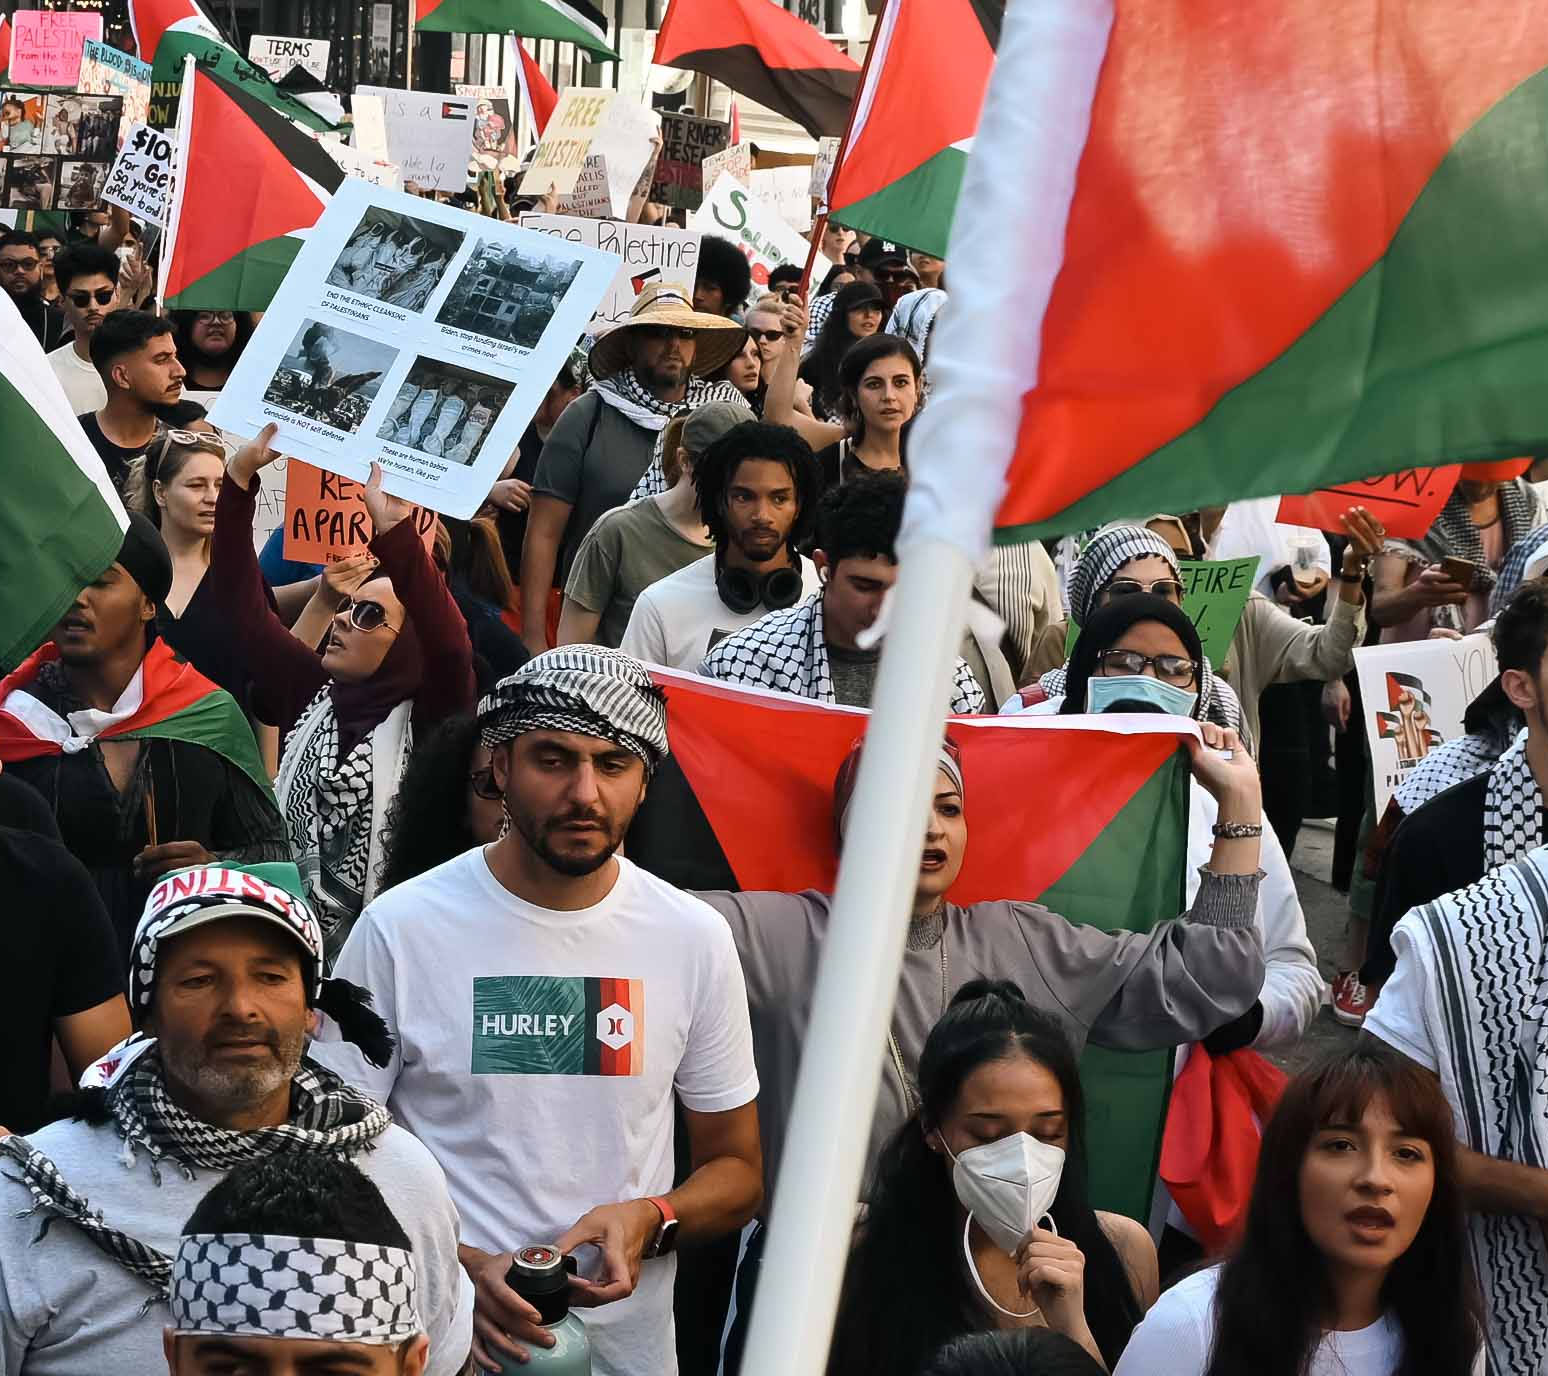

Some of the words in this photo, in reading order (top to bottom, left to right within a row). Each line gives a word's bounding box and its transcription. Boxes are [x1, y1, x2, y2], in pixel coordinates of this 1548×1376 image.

[265, 39, 312, 58] TERMS
[561, 97, 606, 126] FREE
[596, 220, 698, 269] Palestine
[481, 1012, 575, 1037] HURLEY
